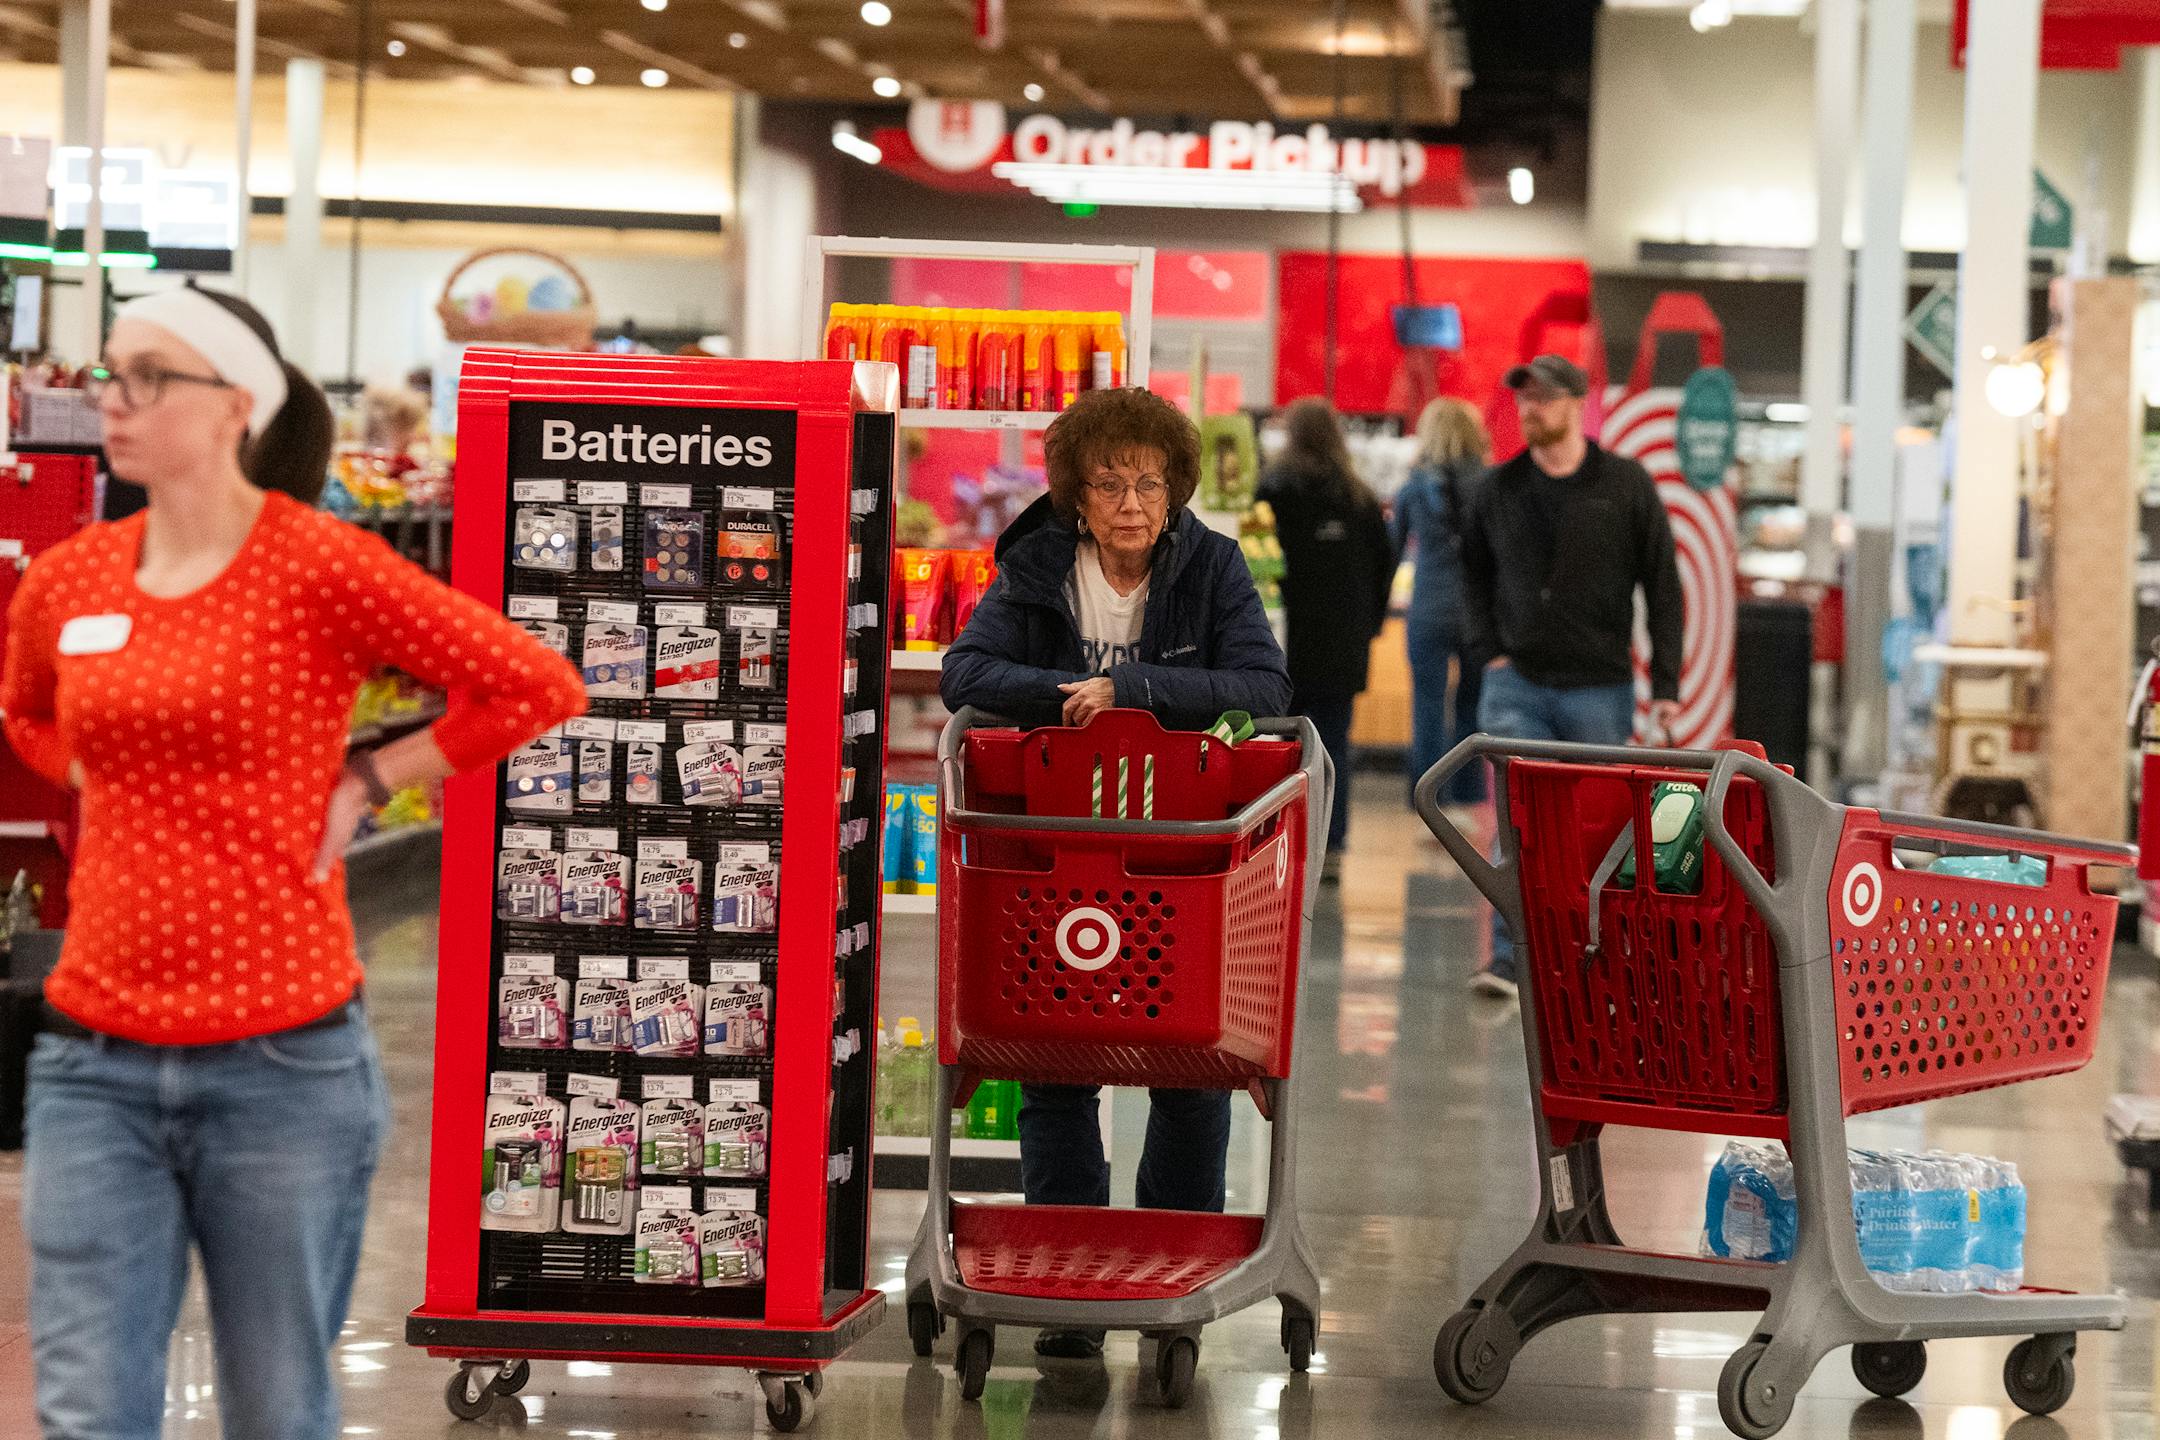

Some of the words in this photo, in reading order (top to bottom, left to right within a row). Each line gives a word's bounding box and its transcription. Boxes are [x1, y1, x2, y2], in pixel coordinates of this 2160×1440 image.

[1013, 114, 1201, 168] Order
[1210, 119, 1427, 198] Pickup
[542, 419, 773, 467] Batteries
[727, 522, 772, 532] DURACELL
[906, 563, 932, 581] 50
[585, 634, 632, 650] Energizer
[658, 636, 718, 656] Energizer
[1168, 644, 1197, 657] Columbia
[512, 751, 559, 768] Energizer
[683, 749, 728, 774] Energizer
[747, 758, 786, 773] Energiz
[642, 847, 661, 855] 14.79
[503, 858, 558, 876] Energizer
[566, 860, 621, 879] Energizer
[640, 866, 695, 885] Energizer
[719, 869, 774, 888] Energizer
[503, 982, 558, 1003] Energizer
[579, 989, 630, 1006] Energize
[635, 982, 686, 1011] Energizer
[709, 991, 764, 1011] Energizer
[575, 1021, 587, 1030] 25
[705, 1028, 717, 1036] 10
[489, 1108, 554, 1129] Energizer
[571, 1111, 636, 1132] Energizer
[645, 1108, 698, 1126] Energizer
[707, 1112, 764, 1133] Energizer
[645, 1194, 664, 1202] 13.79
[708, 1196, 727, 1204] 13.79
[640, 1216, 692, 1235] Energizer
[702, 1218, 758, 1245] Energizer
[1869, 1220, 1921, 1231] Drinki
[1921, 1219, 1958, 1230] Water
